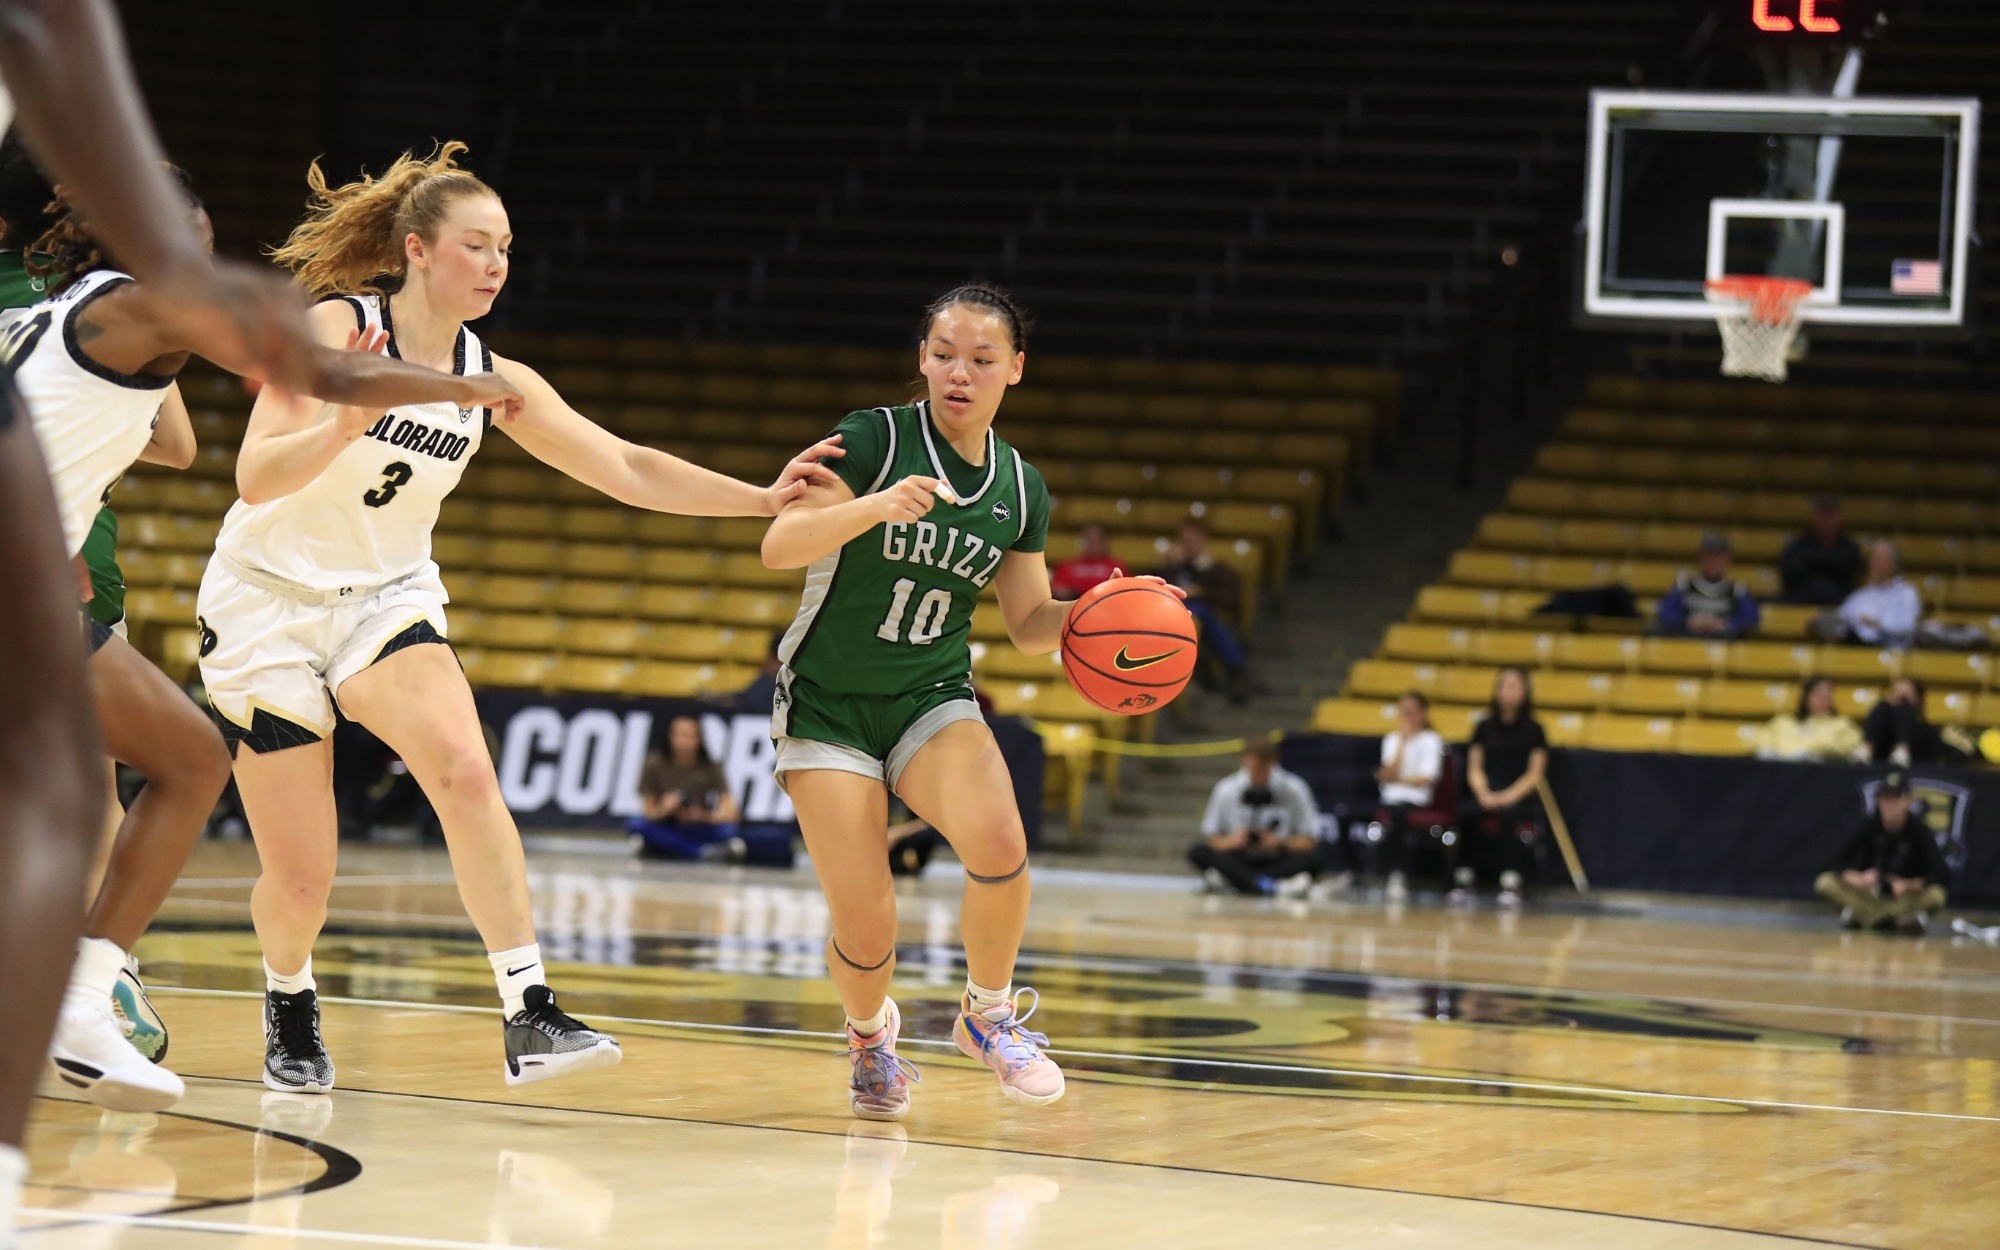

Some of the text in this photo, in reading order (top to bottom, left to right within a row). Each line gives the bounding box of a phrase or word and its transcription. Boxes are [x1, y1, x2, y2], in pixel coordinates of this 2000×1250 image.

[364, 414, 470, 461] OLORADO
[363, 461, 413, 508] 3
[882, 520, 1003, 588] GRIZZ
[877, 577, 952, 645] 10
[500, 705, 804, 824] COLR
